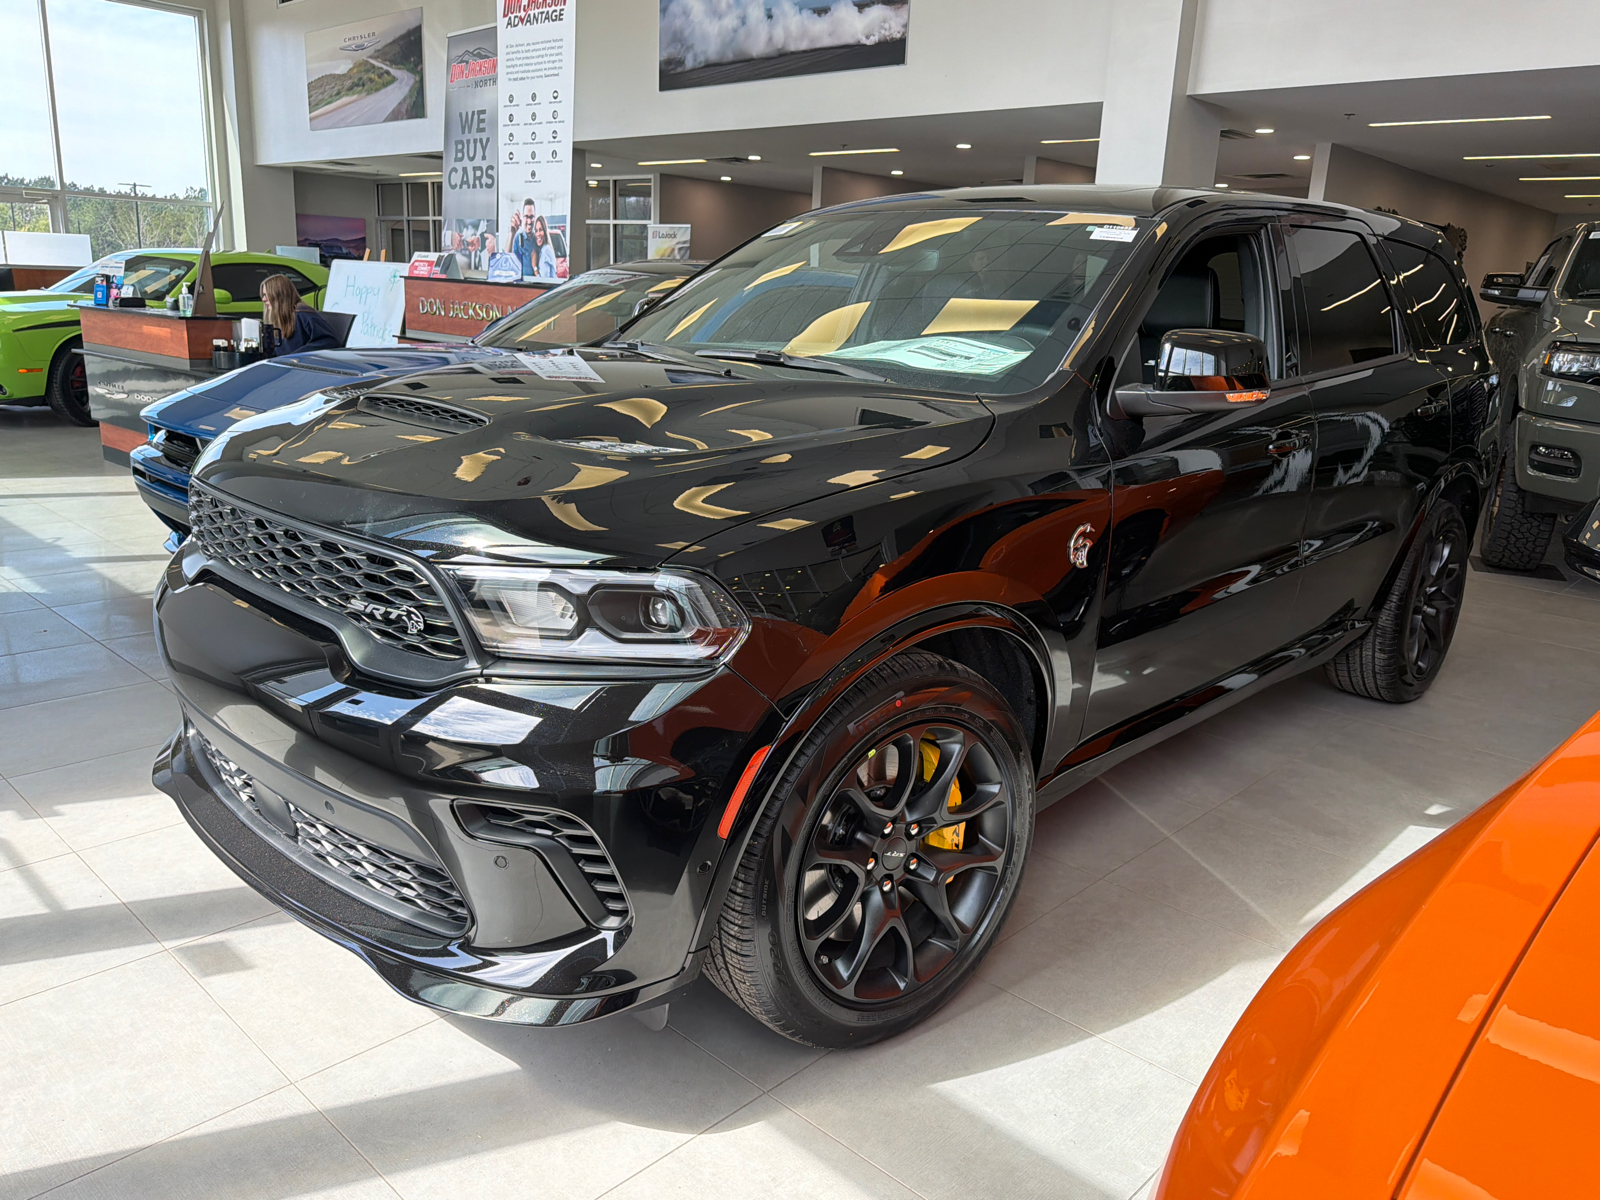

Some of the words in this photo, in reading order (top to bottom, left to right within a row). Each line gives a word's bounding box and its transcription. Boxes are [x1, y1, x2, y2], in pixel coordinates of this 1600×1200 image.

[503, 0, 522, 18] DON
[506, 8, 564, 29] ADVANTAGE
[344, 32, 376, 42] CHRYSLER
[450, 63, 465, 83] DON
[465, 58, 498, 80] JACKSON
[474, 78, 497, 90] NORTH
[458, 109, 487, 135] WE
[454, 137, 490, 163] BUY
[448, 164, 496, 190] CARS
[344, 276, 380, 306] Happy
[420, 296, 445, 317] DON
[448, 300, 502, 322] JACKSON
[134, 393, 158, 402] DOD
[346, 599, 407, 620] SRT
[761, 878, 770, 917] OUTSIDE
